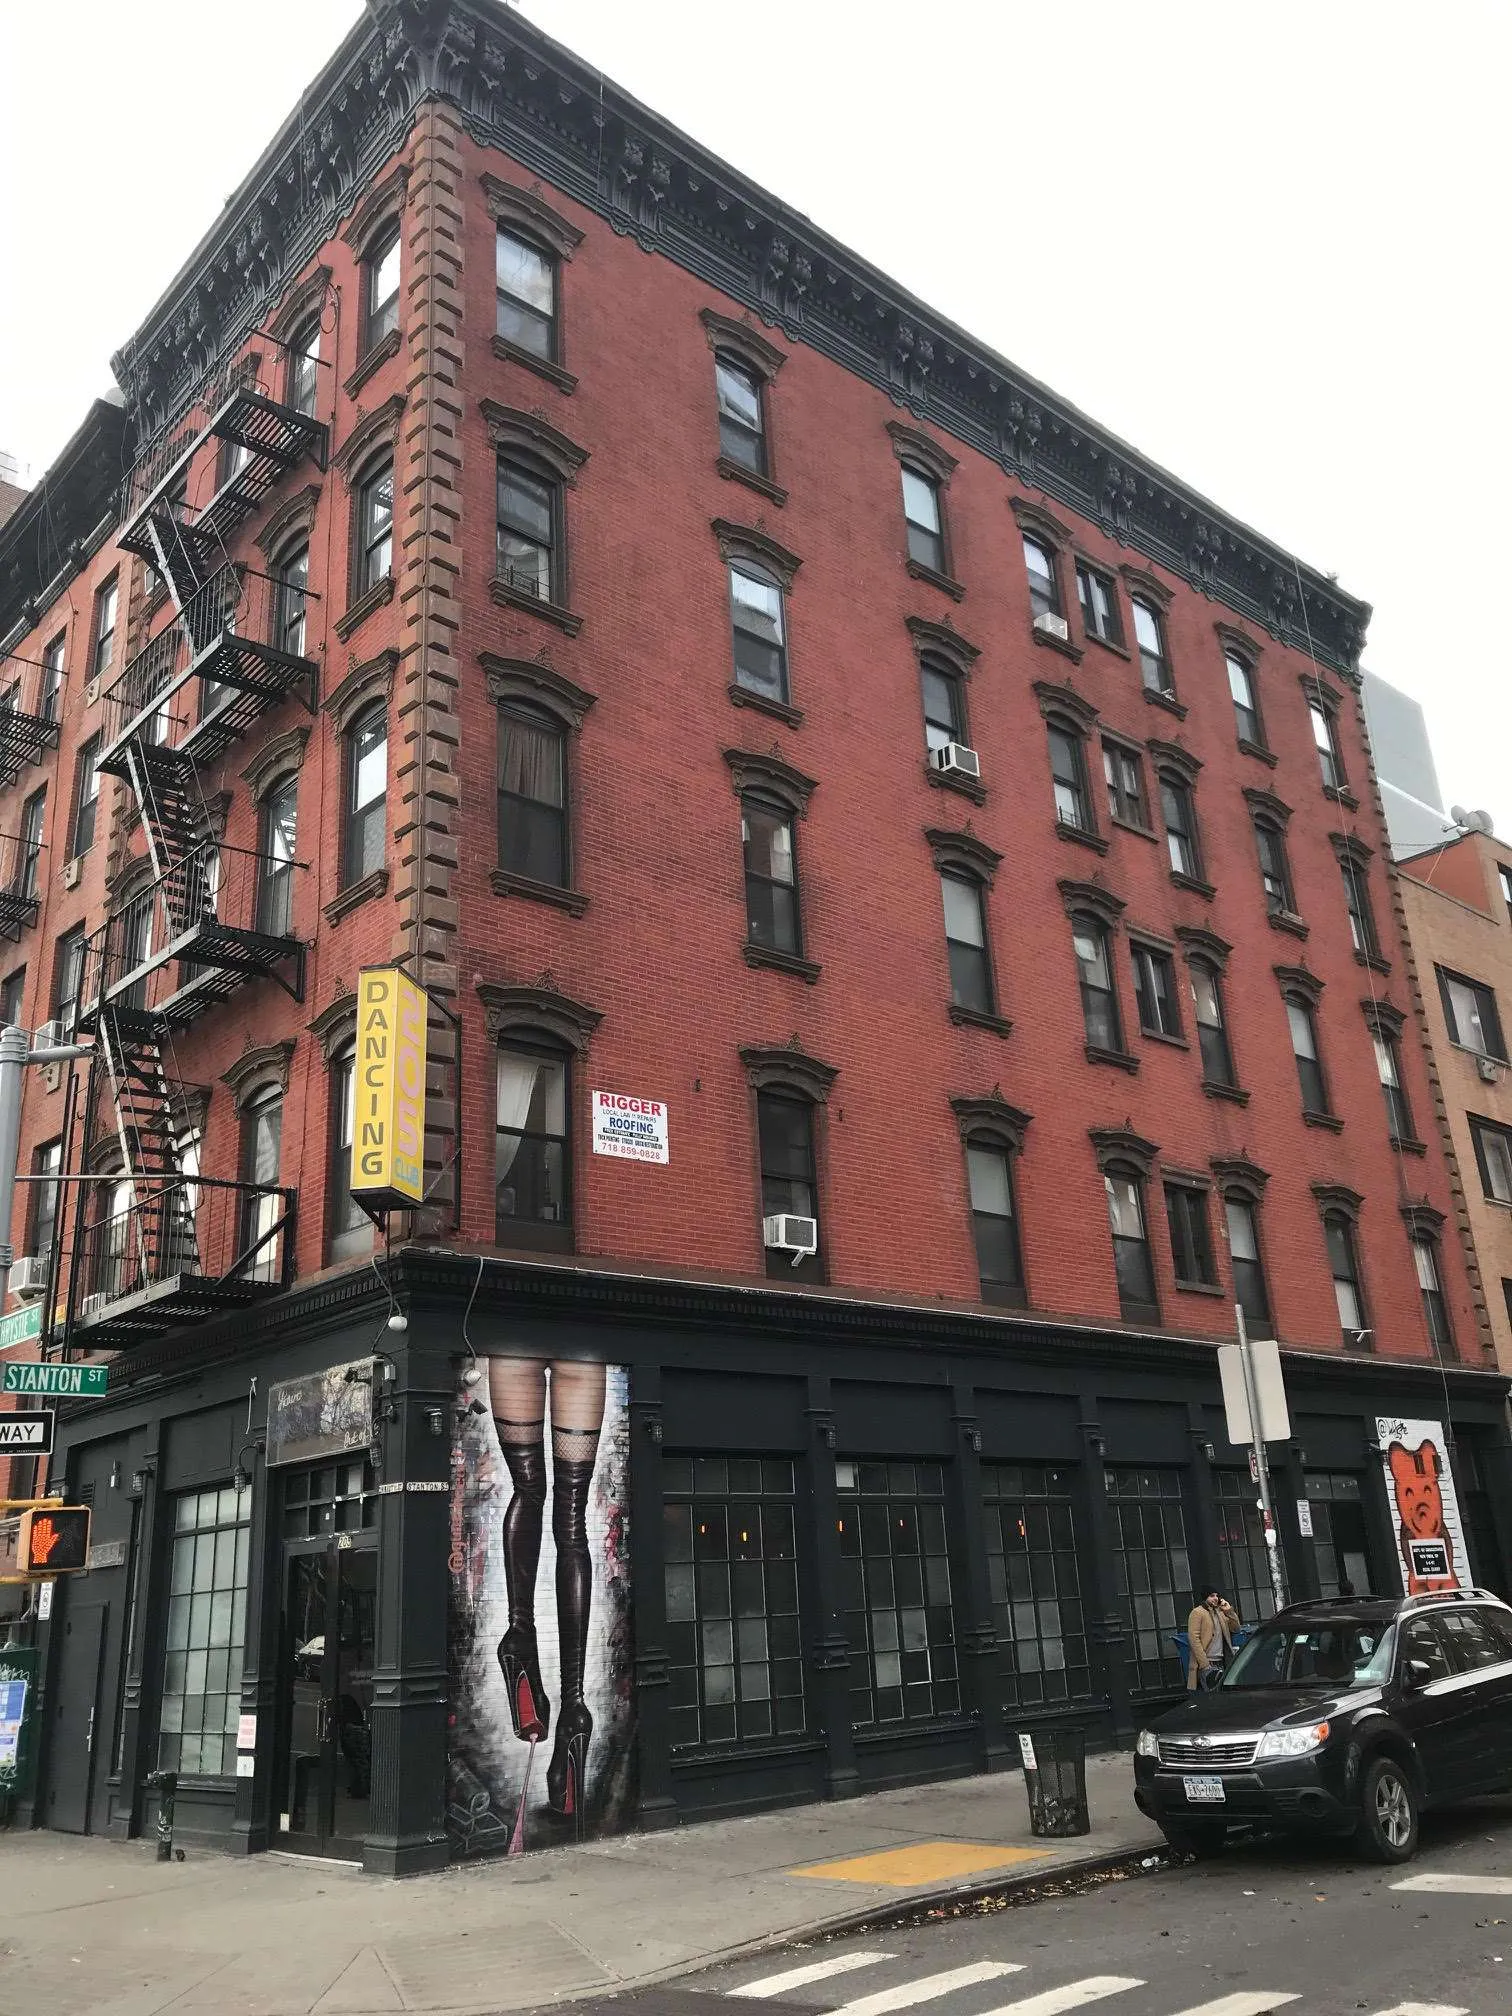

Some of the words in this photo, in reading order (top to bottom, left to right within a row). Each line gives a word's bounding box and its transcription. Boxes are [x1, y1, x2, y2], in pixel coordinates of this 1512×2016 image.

[361, 981, 389, 1176] DANCING
[599, 1093, 662, 1117] RIGGER
[602, 1108, 619, 1117] LOCAL
[609, 1117, 654, 1134] ROOFING
[602, 1142, 618, 1152] 718
[620, 1145, 661, 1159] 859-0828
[0, 1313, 28, 1344] HRYSTIE
[31, 1310, 39, 1322] ST
[6, 1365, 82, 1392] STANTON
[88, 1370, 103, 1383] ST
[0, 1425, 36, 1442] WAY
